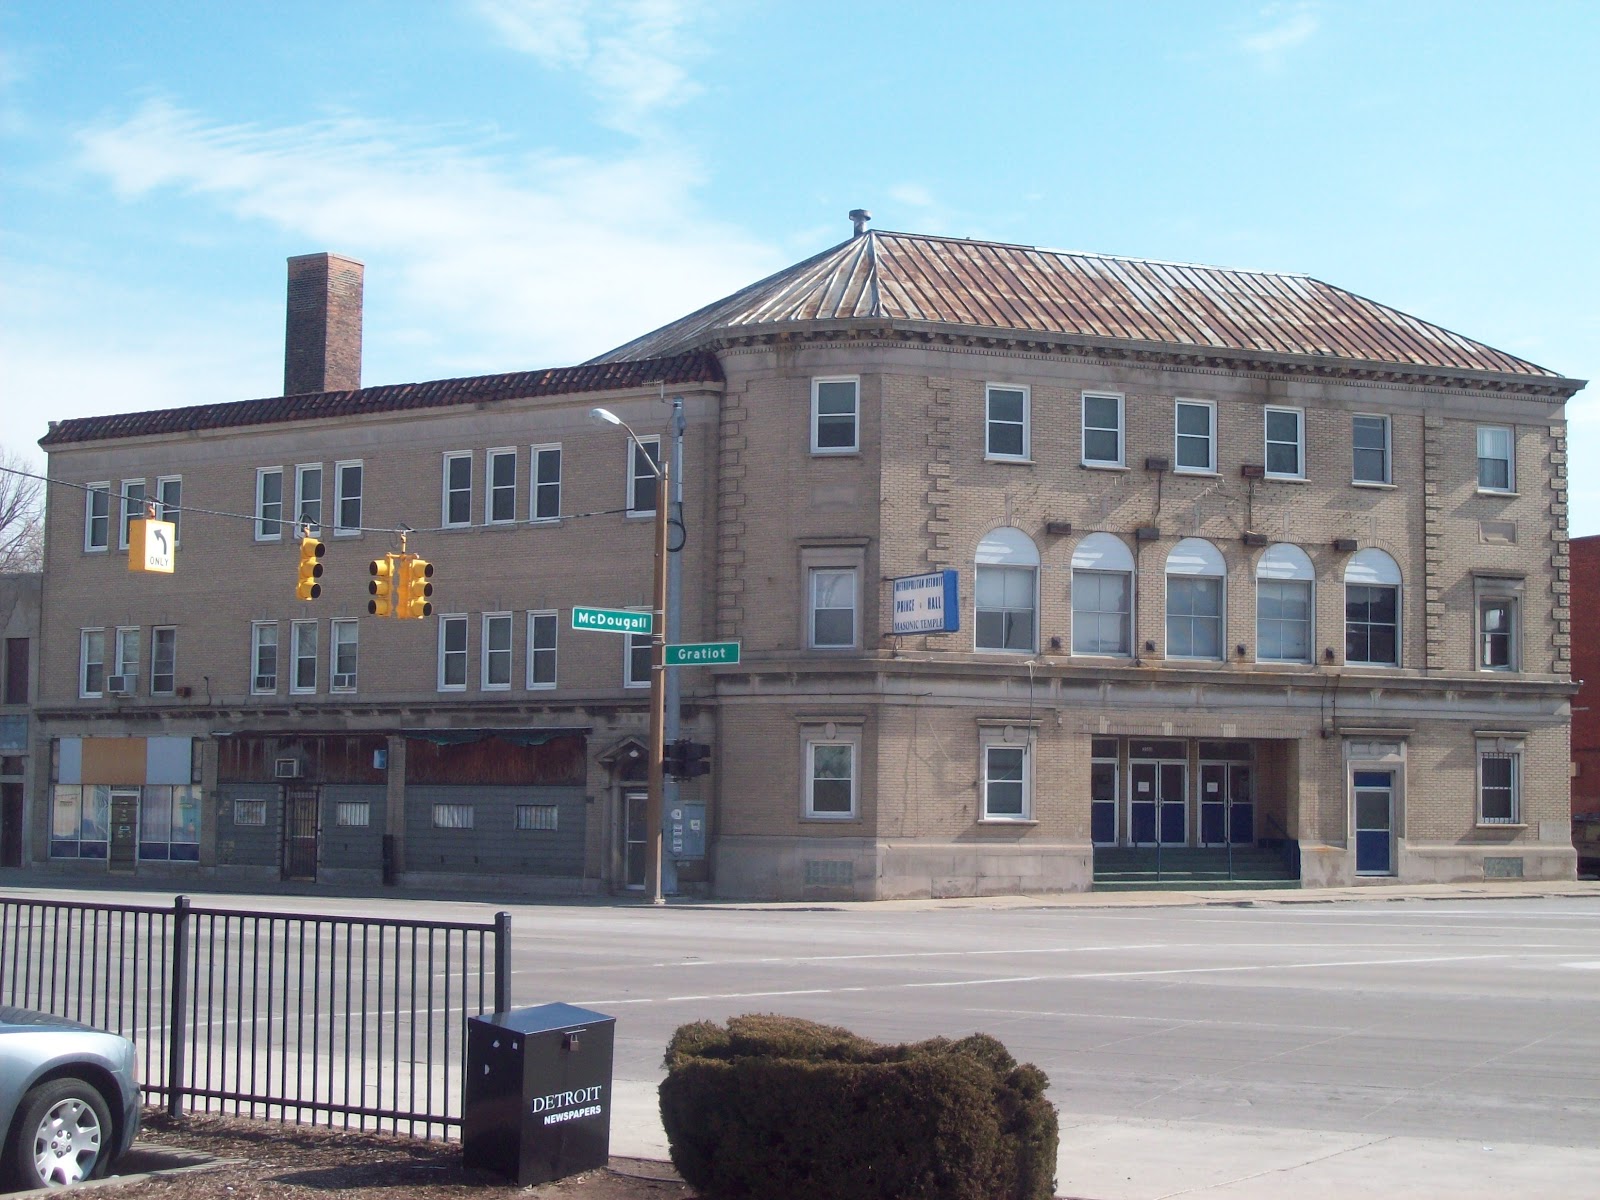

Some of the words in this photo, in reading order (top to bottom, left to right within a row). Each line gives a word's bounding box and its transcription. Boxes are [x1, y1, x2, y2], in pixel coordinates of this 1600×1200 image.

[150, 556, 169, 567] ONLY
[925, 576, 943, 588] DETROIT
[896, 599, 915, 613] PRINCE
[927, 596, 941, 610] HALL
[578, 612, 647, 630] McDougall
[894, 620, 919, 631] MASONIC
[920, 618, 943, 629] TEMPLE
[678, 647, 726, 660] Gratiot
[532, 1085, 602, 1113] DETROIT
[543, 1105, 602, 1125] NEWSPAPERS
